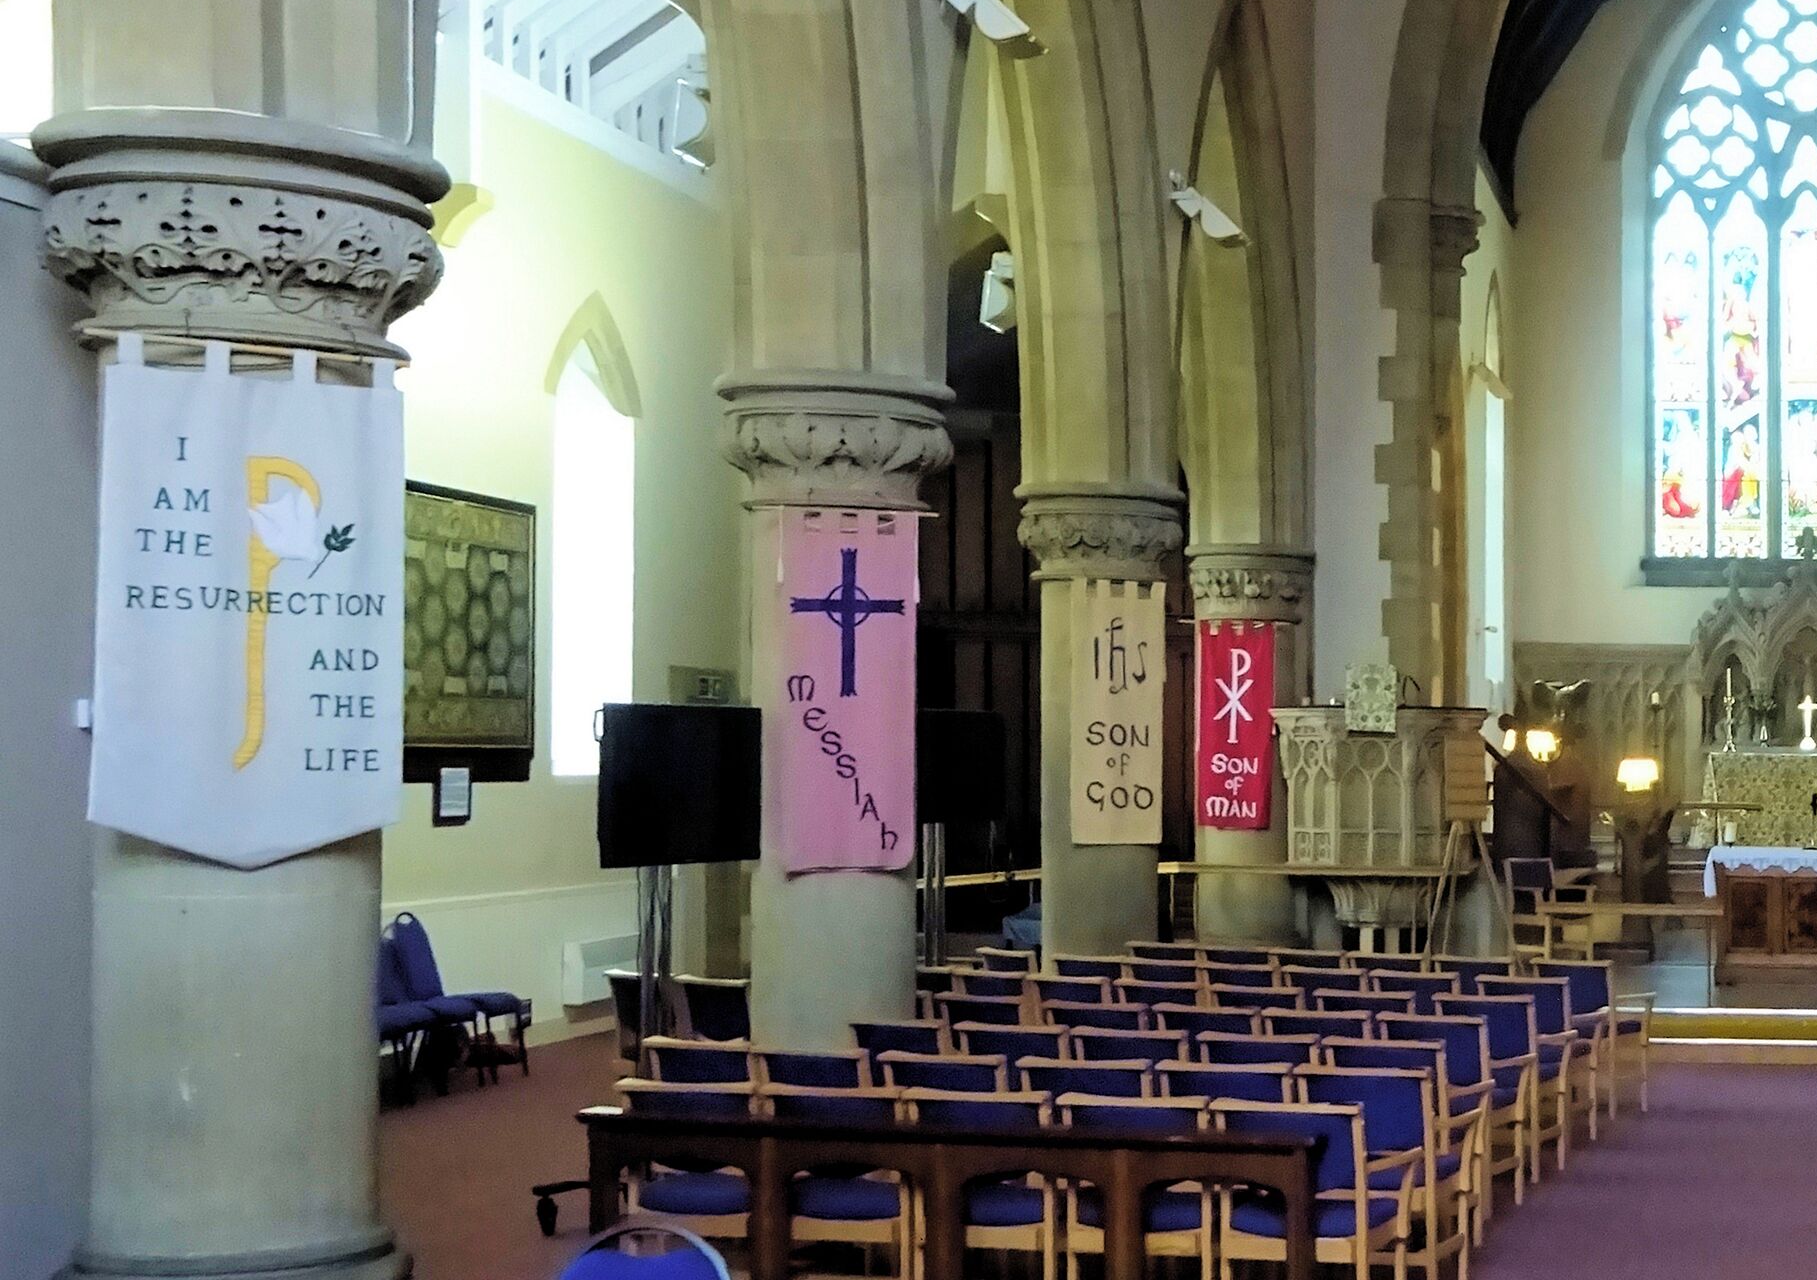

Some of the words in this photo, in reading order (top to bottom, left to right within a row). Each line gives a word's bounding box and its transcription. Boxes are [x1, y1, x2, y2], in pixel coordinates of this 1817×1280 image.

[176, 436, 188, 461] I
[153, 487, 211, 513] AM
[134, 528, 214, 557] THE
[124, 584, 386, 617] RESURRECTION
[308, 647, 380, 671] AND
[309, 693, 376, 718] THE
[1085, 721, 1150, 747] SON
[304, 748, 381, 772] LIFE
[1210, 752, 1259, 775] SON
[1086, 781, 1155, 812] GOD
[1205, 796, 1257, 818] MAN
